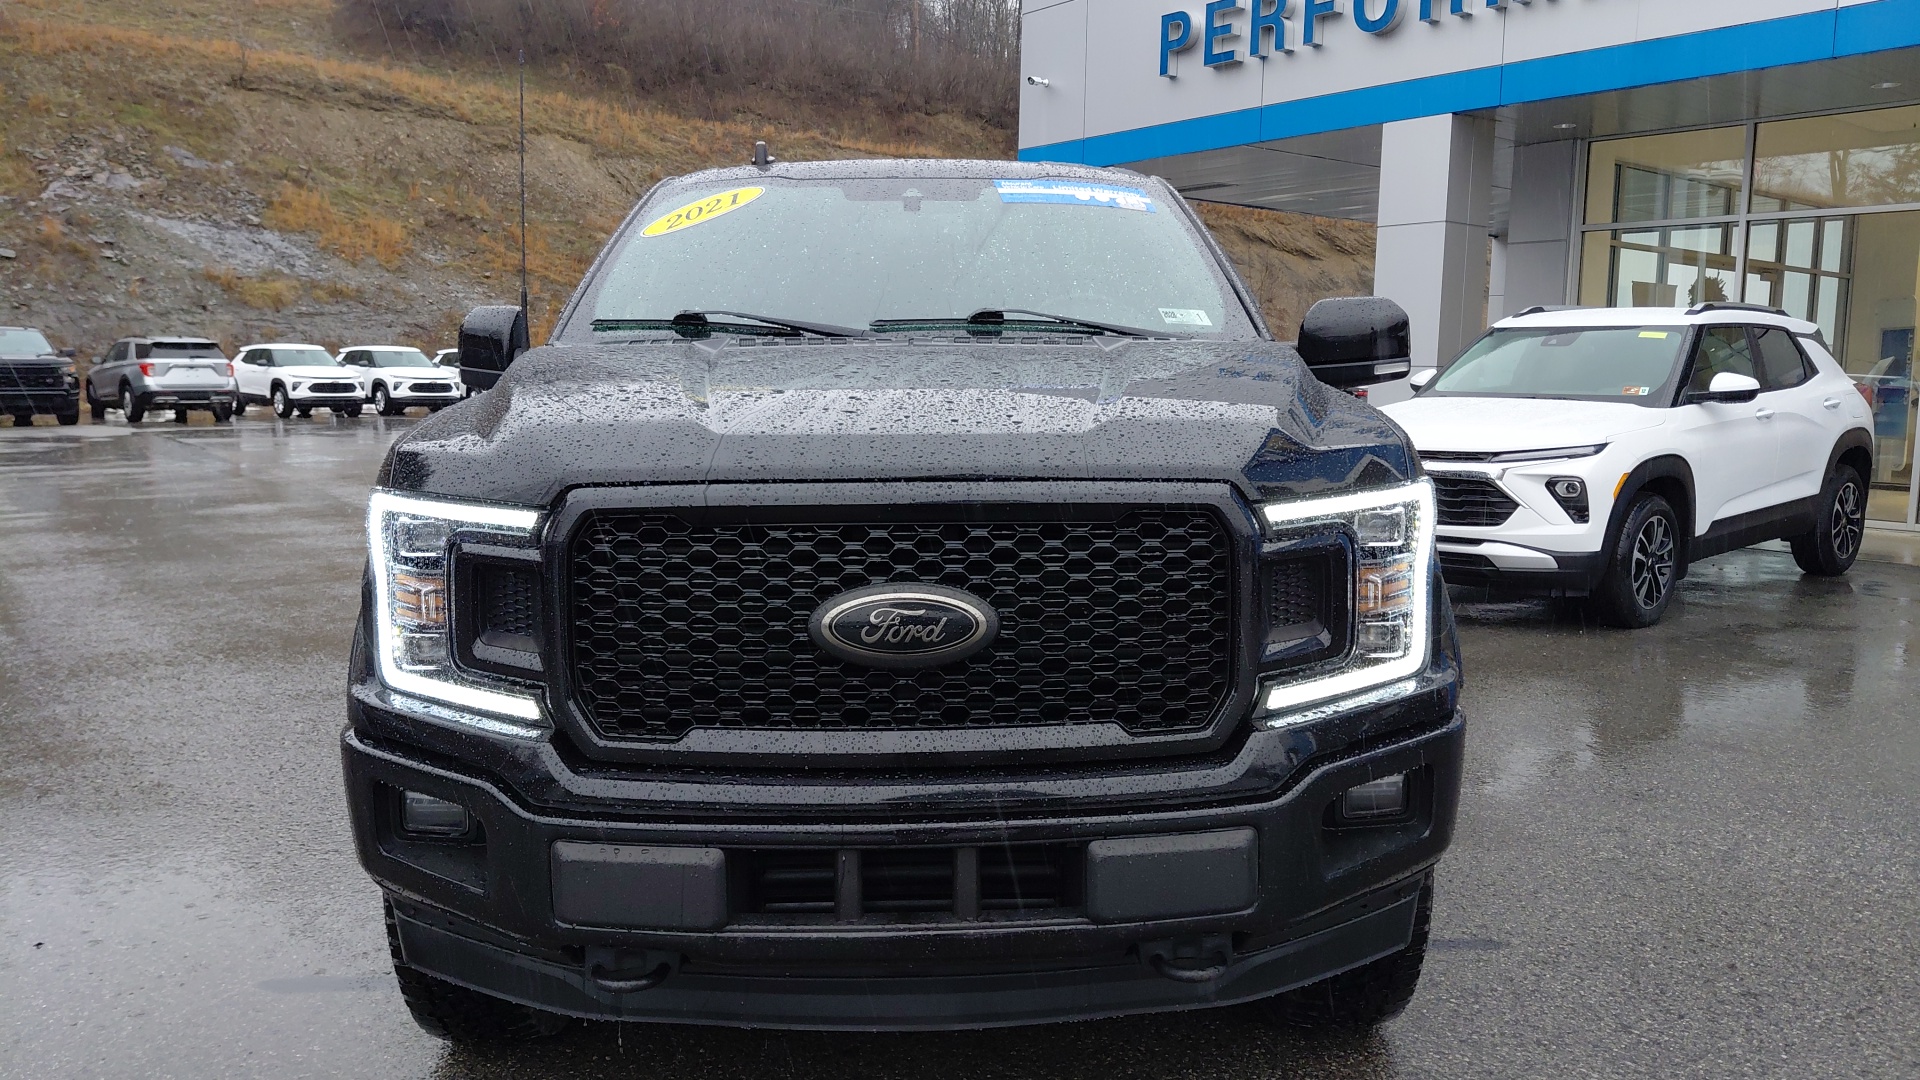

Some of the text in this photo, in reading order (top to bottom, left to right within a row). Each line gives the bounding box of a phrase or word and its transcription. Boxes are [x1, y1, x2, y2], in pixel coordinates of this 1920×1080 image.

[1159, 0, 1532, 79] PERFO
[666, 193, 741, 231] 2021
[861, 606, 948, 643] Ford
